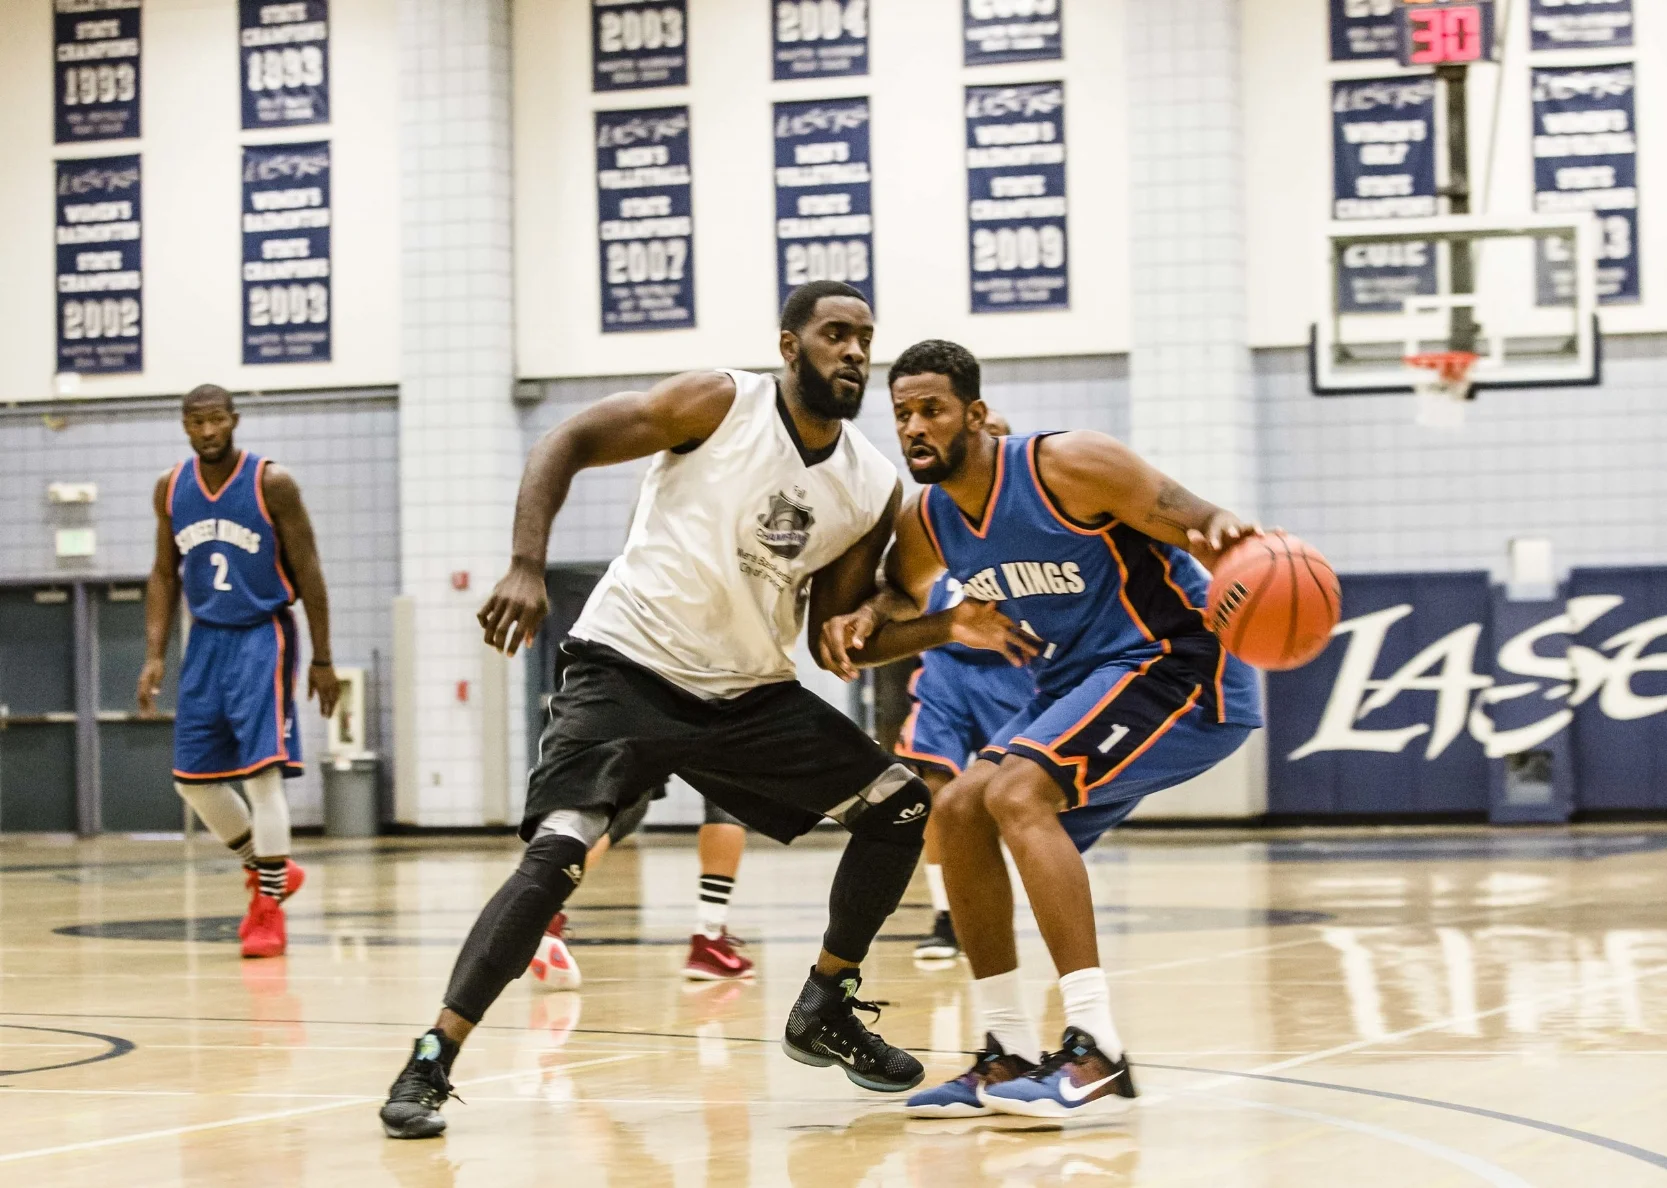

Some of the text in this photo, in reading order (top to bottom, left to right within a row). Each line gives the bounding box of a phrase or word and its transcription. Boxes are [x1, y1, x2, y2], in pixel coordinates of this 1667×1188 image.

[600, 7, 683, 53] 2003
[1409, 5, 1481, 64] 30
[606, 238, 687, 284] 2007
[973, 225, 1064, 272] 2009
[64, 297, 139, 340] 2002
[249, 283, 327, 326] 2003
[209, 552, 233, 591] 2
[1000, 561, 1086, 598] KINGS
[1097, 723, 1130, 754] 1
